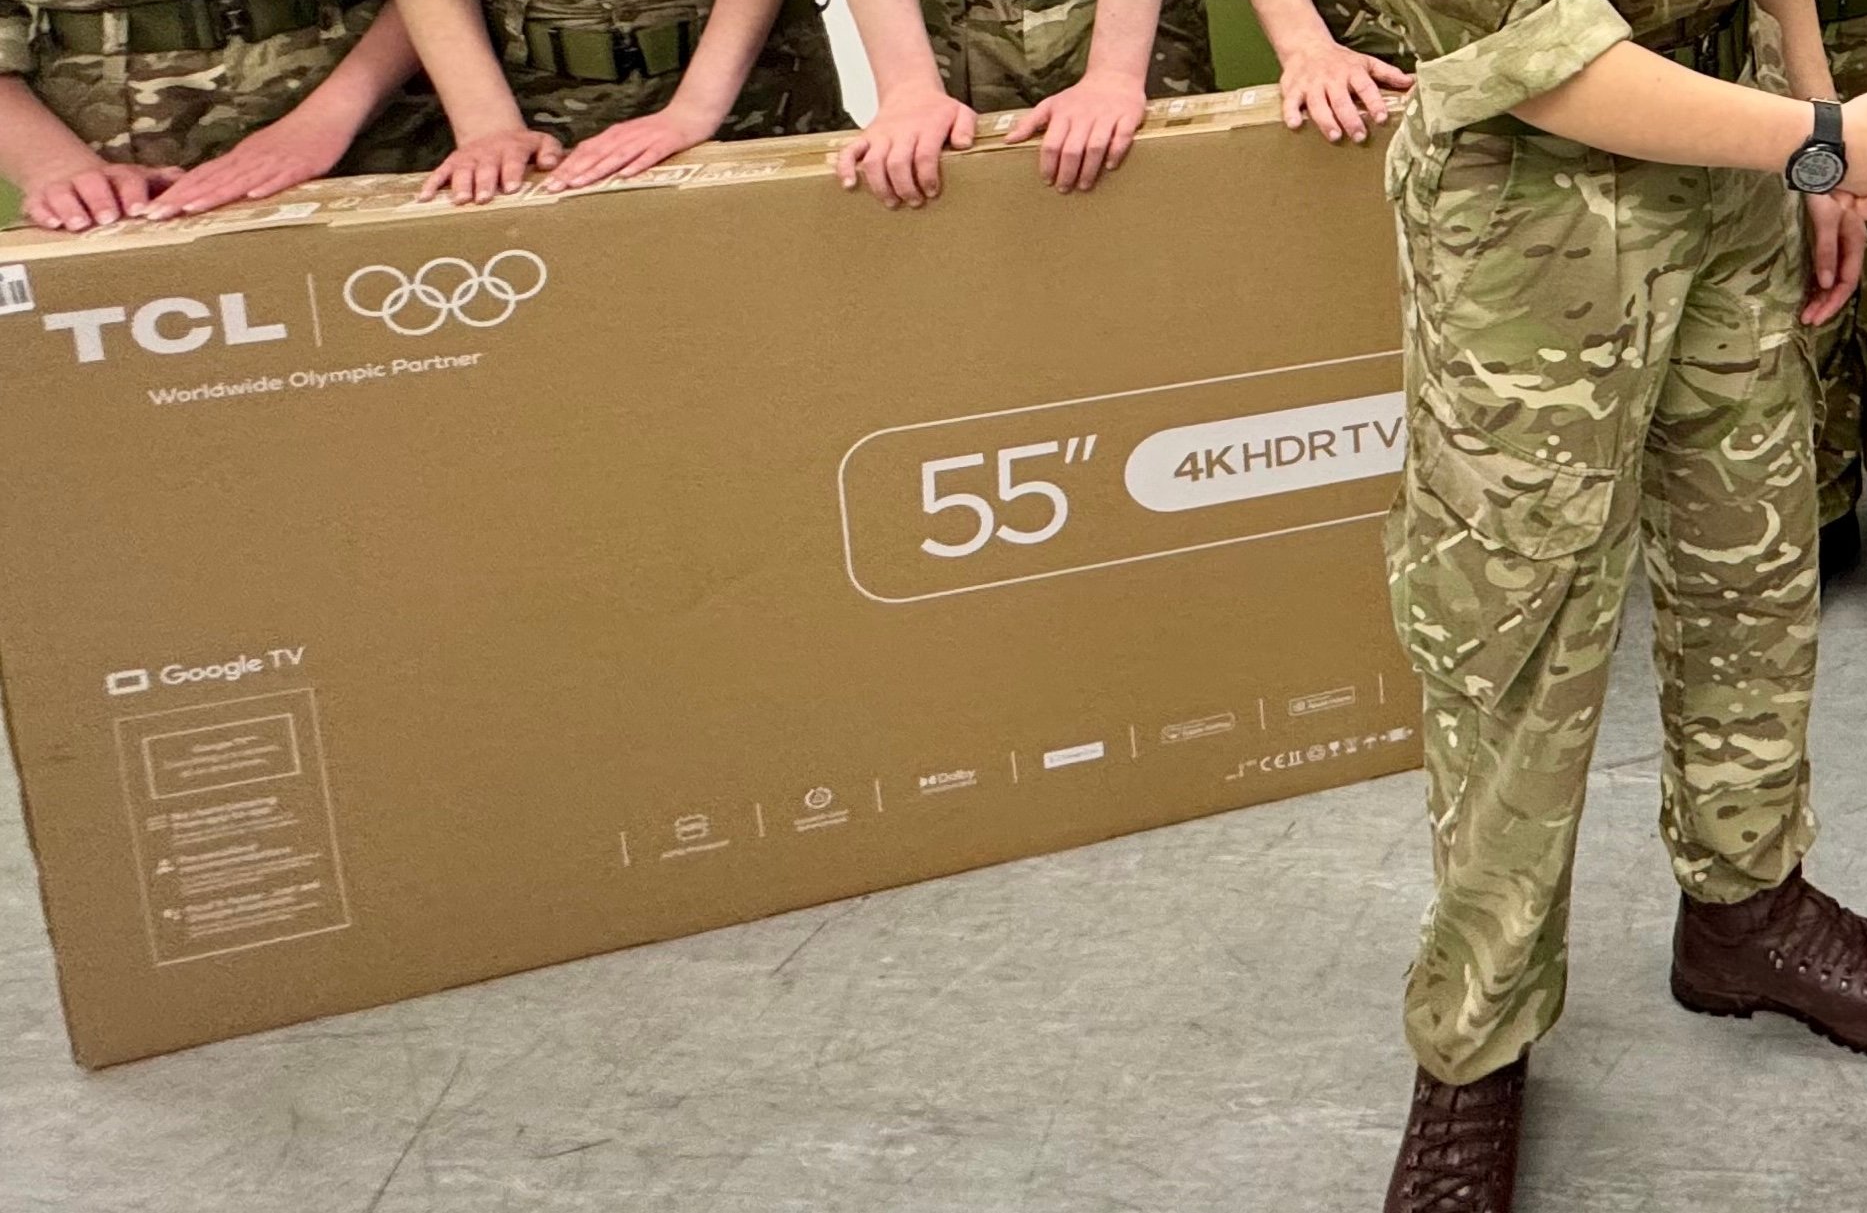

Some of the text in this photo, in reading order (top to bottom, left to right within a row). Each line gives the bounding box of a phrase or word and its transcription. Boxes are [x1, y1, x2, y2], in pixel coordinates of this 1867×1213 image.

[43, 291, 288, 363] TCL
[147, 352, 483, 405] Worldwide Olympic Partner
[920, 434, 1098, 558] 55"
[1342, 416, 1404, 455] TV
[160, 645, 306, 685] Google TV
